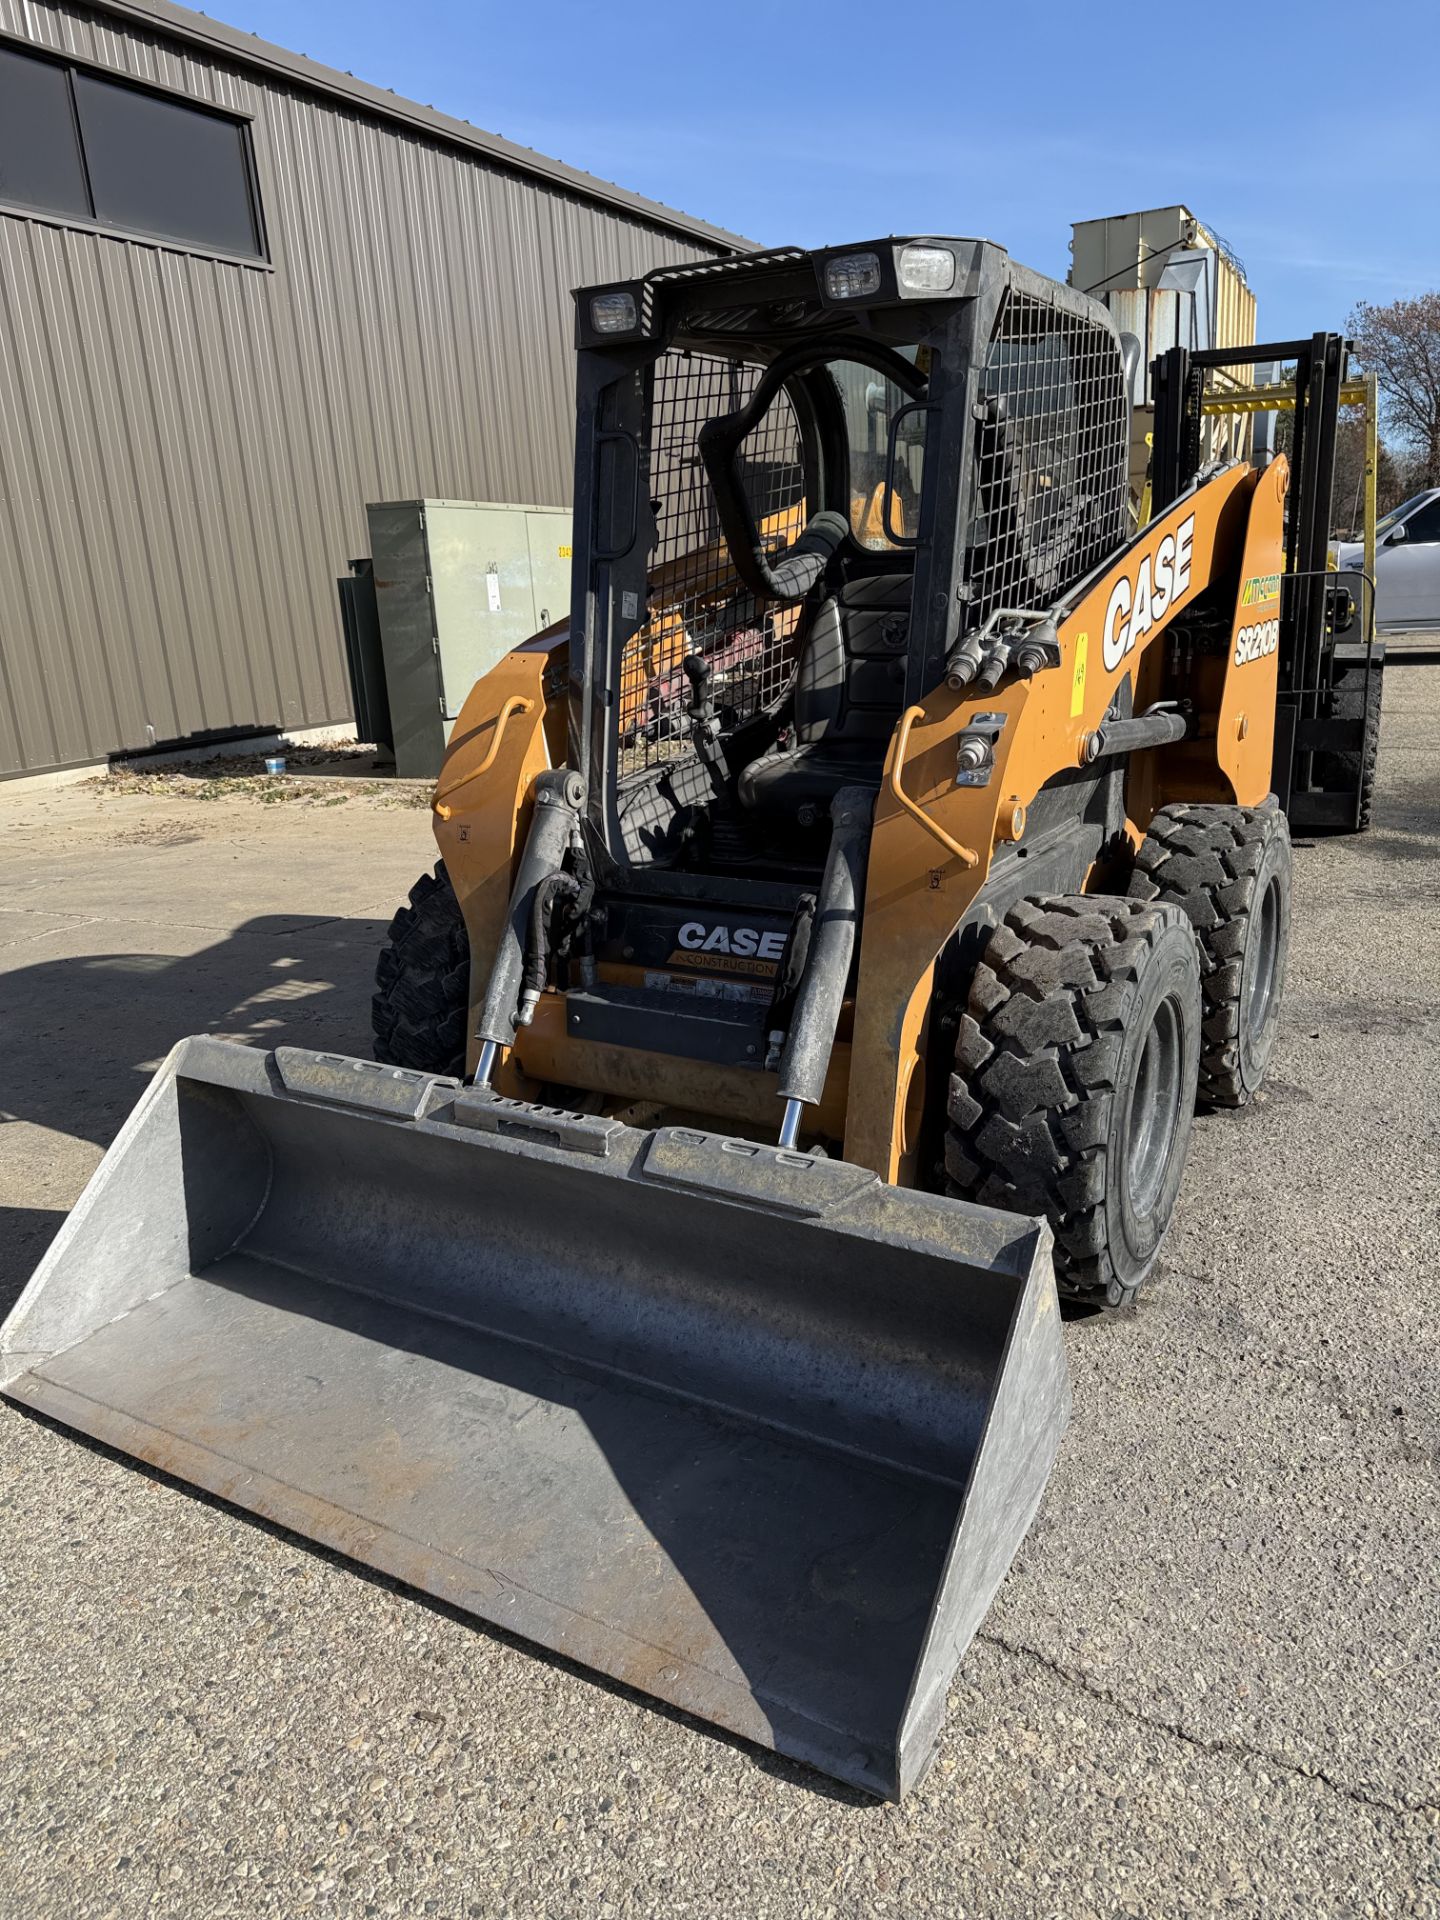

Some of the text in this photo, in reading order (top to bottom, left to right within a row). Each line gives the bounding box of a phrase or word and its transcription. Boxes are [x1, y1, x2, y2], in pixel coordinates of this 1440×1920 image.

[1102, 511, 1195, 673] CASE
[1235, 617, 1279, 667] SR210B
[678, 922, 788, 960] CASE
[687, 953, 775, 975] CONSTRUCTION
